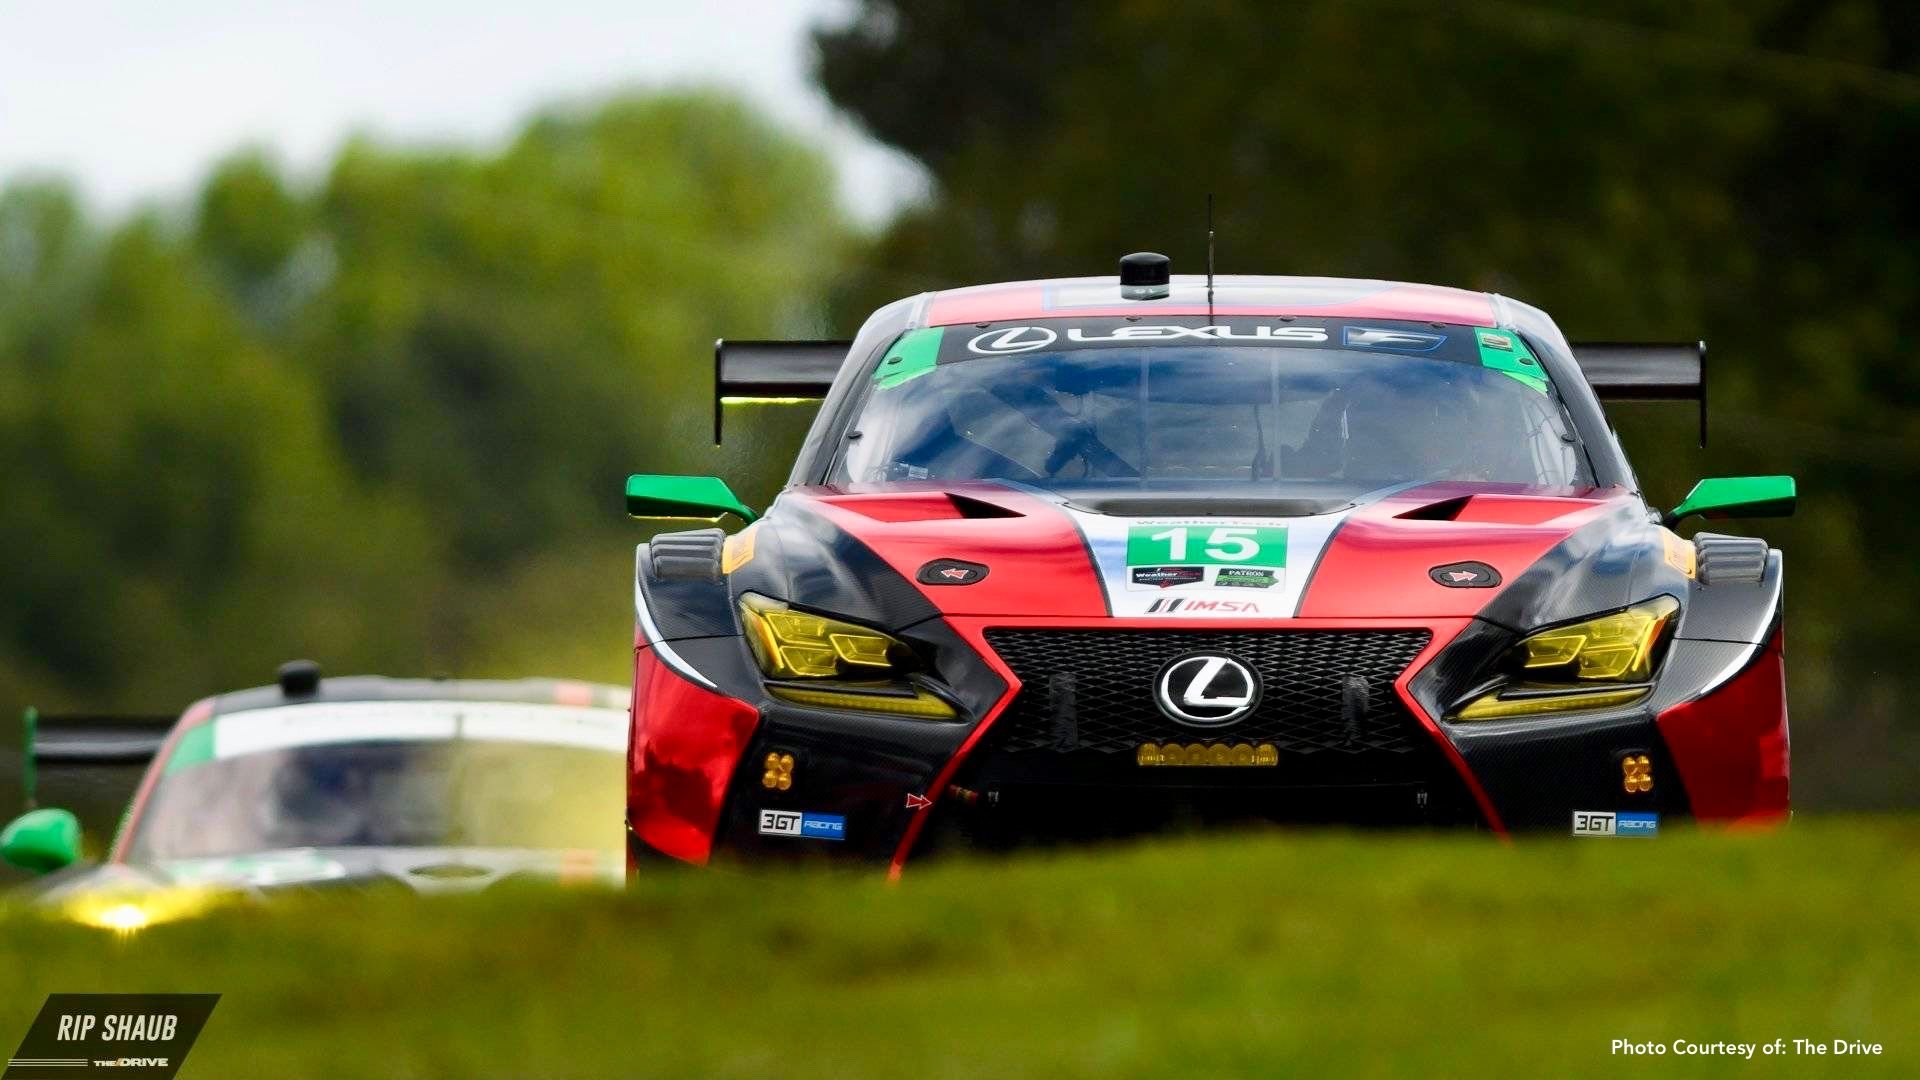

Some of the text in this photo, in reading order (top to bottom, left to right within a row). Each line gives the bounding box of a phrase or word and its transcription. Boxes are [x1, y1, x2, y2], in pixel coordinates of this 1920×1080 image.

[1067, 325, 1329, 343] LEXUS
[1151, 527, 1261, 562] 15
[1184, 599, 1261, 614] IMSA
[762, 813, 801, 831] 3GT
[1575, 815, 1615, 832] 3GT
